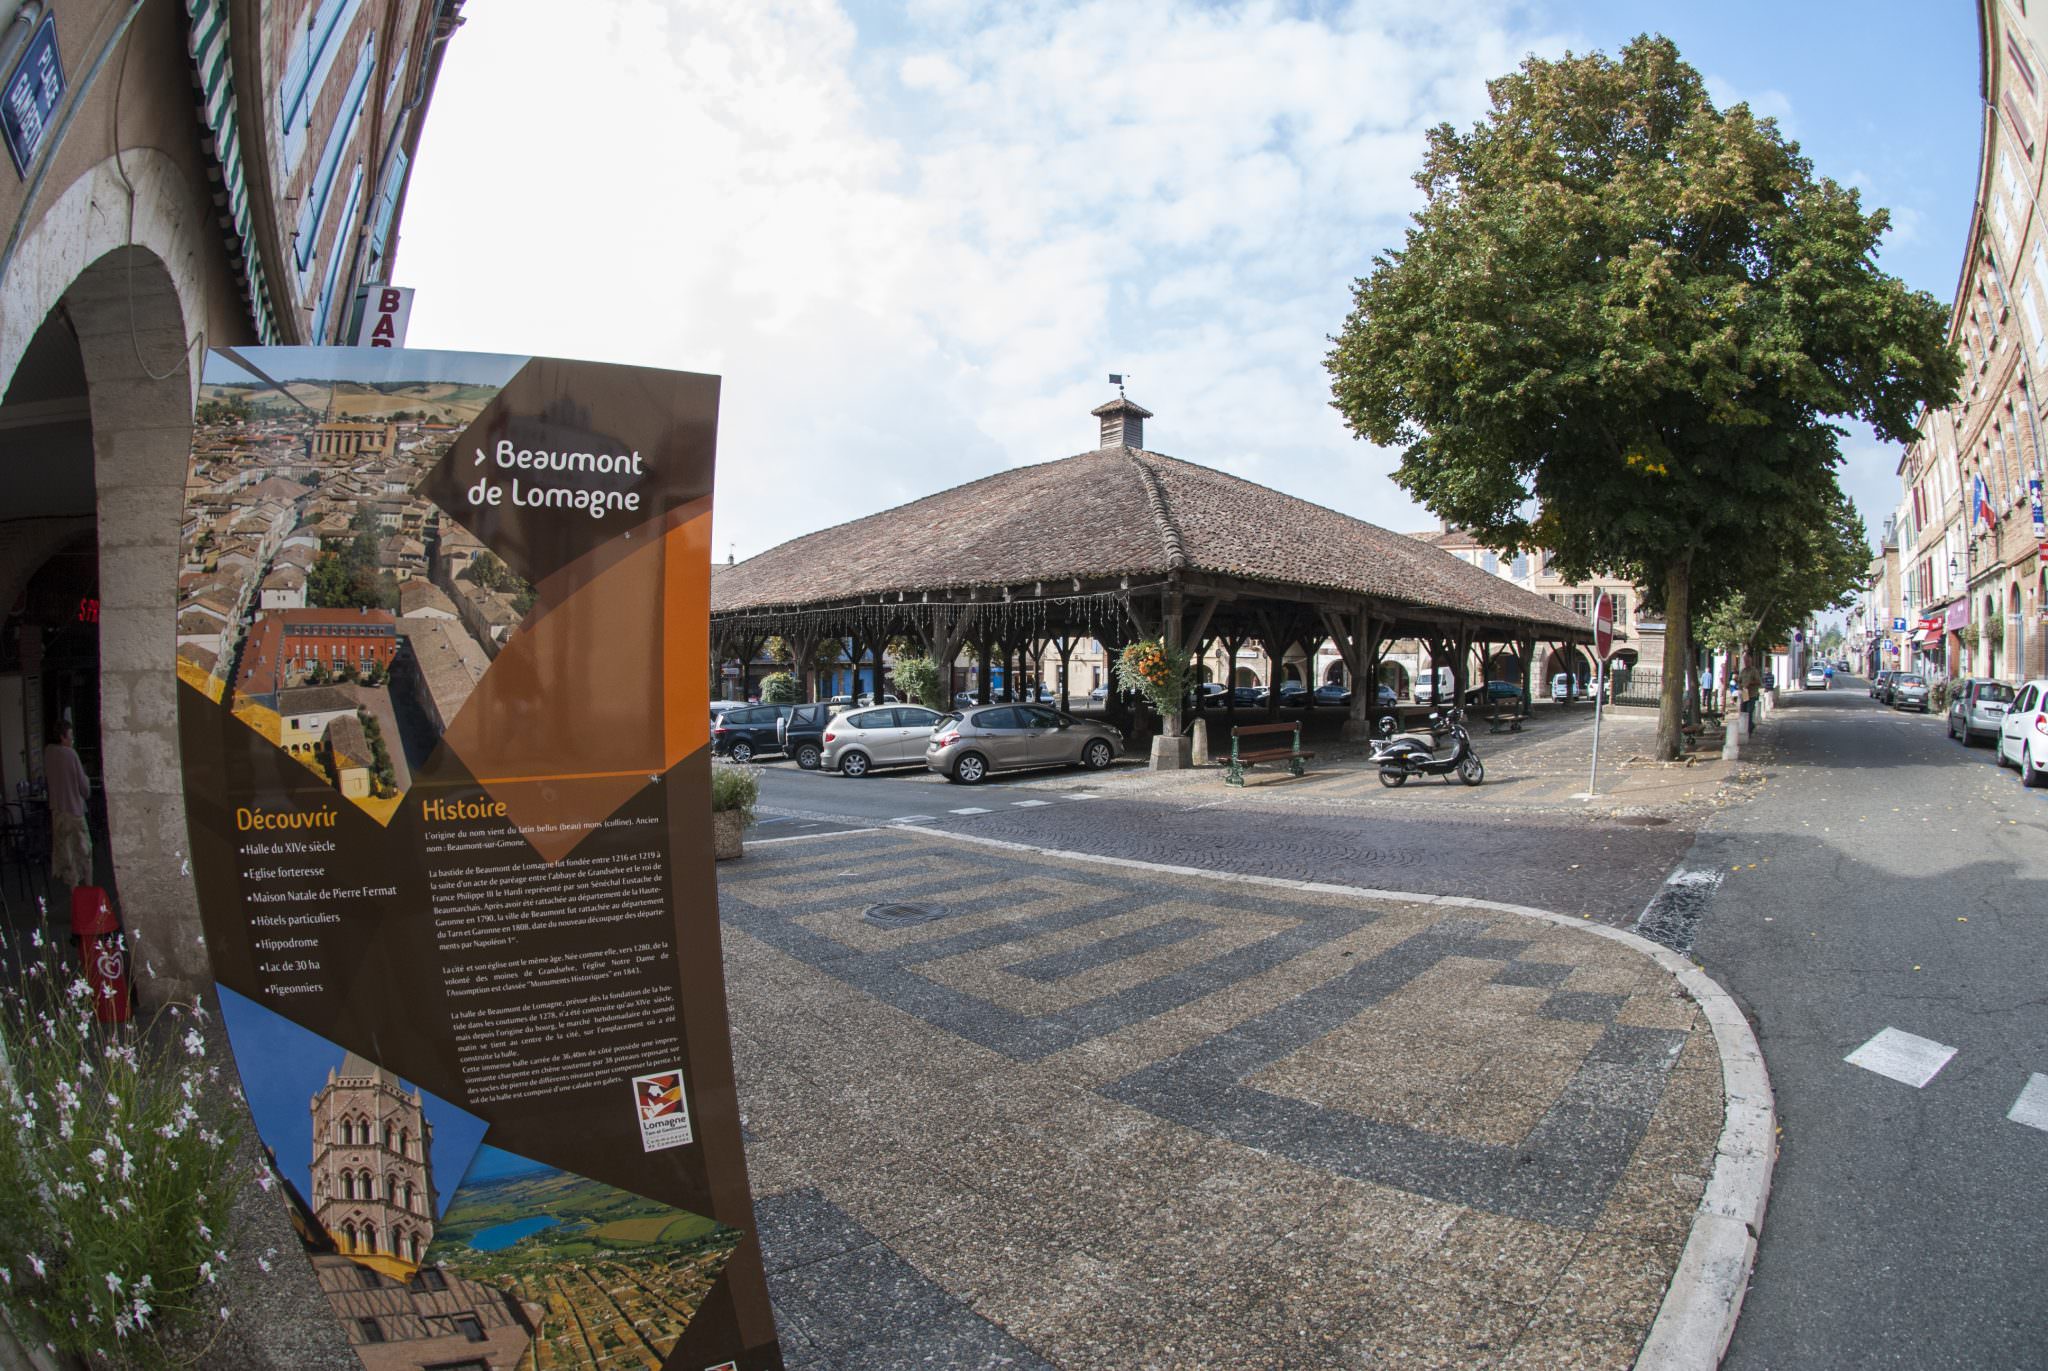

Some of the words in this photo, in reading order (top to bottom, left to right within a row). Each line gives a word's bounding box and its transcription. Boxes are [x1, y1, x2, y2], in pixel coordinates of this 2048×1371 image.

[37, 44, 60, 109] PLACE
[496, 439, 643, 475] Beaumont
[467, 477, 503, 506] de
[512, 478, 640, 519] Lomagne
[423, 796, 507, 821] Histoire
[236, 804, 338, 831] Découvrir
[246, 843, 270, 855] Halle
[271, 842, 284, 854] du
[285, 842, 307, 853] XIVe
[308, 840, 336, 852] siècle
[278, 866, 325, 878] forteresse
[252, 891, 286, 903] Maison
[287, 889, 318, 901] Natale
[319, 888, 331, 900] de
[332, 887, 361, 899] Pierre
[362, 886, 397, 897] Fermat
[256, 914, 287, 926] Hôtels
[288, 912, 341, 927] particuliers
[261, 937, 319, 951] Hippodrome
[265, 961, 281, 973] Lac
[282, 960, 294, 972] de
[295, 960, 307, 971] 30
[308, 959, 320, 970] ha
[270, 982, 324, 996] Pigeonniers
[643, 1116, 686, 1130] Lomagne
